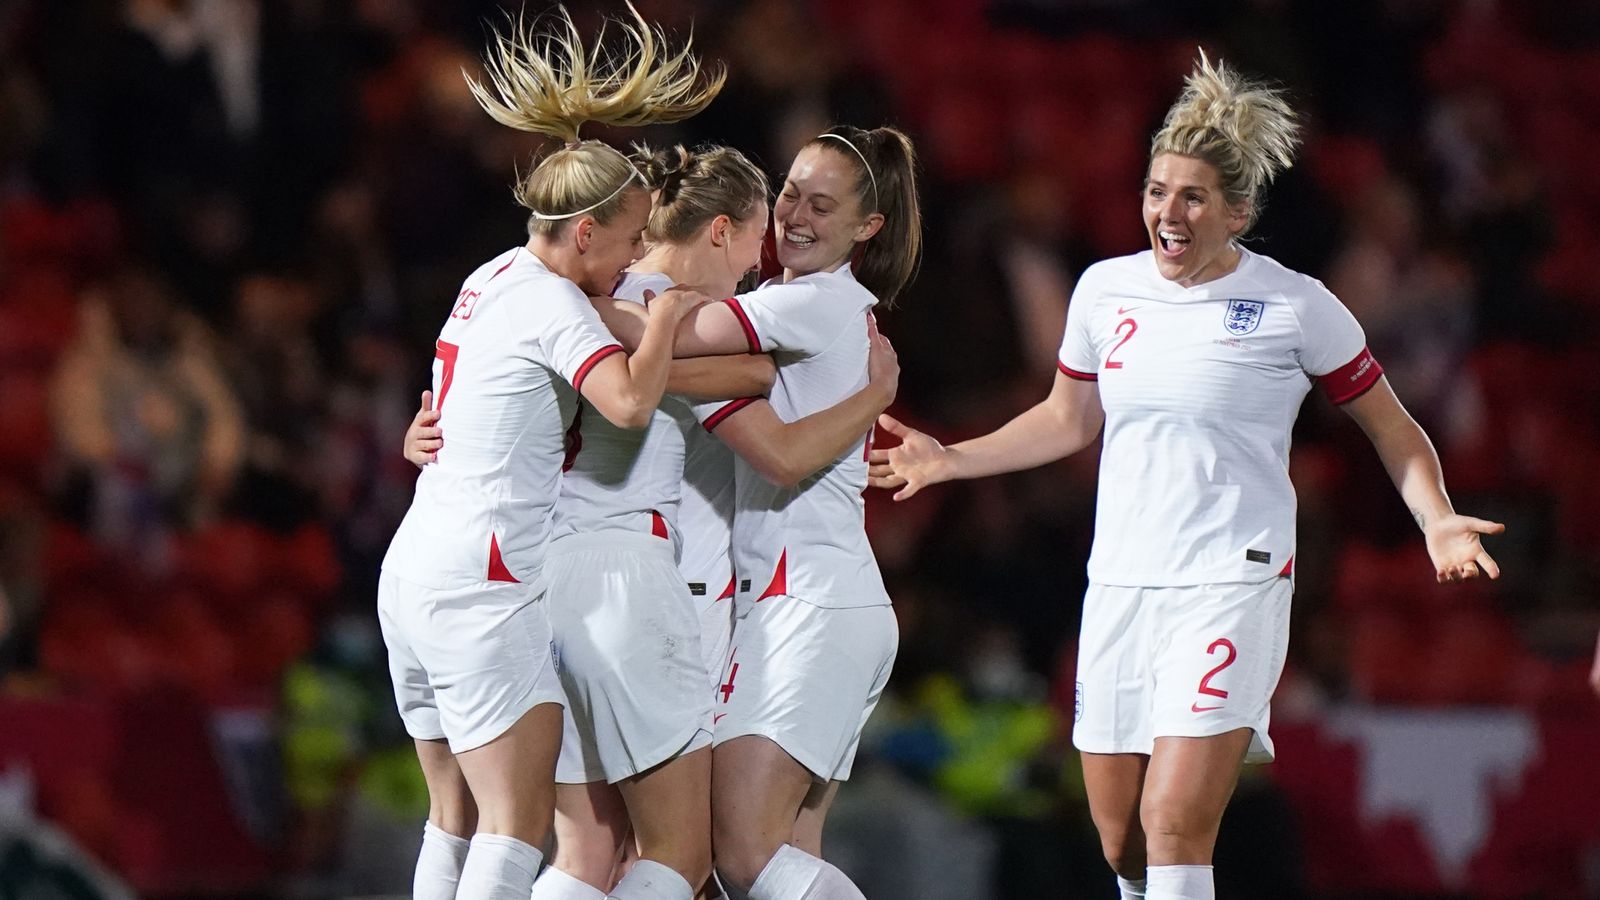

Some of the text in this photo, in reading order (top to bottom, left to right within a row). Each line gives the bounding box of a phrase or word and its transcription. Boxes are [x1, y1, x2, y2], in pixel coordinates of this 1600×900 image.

[1105, 318, 1138, 369] 2
[435, 338, 460, 426] 7
[1197, 637, 1238, 700] 2
